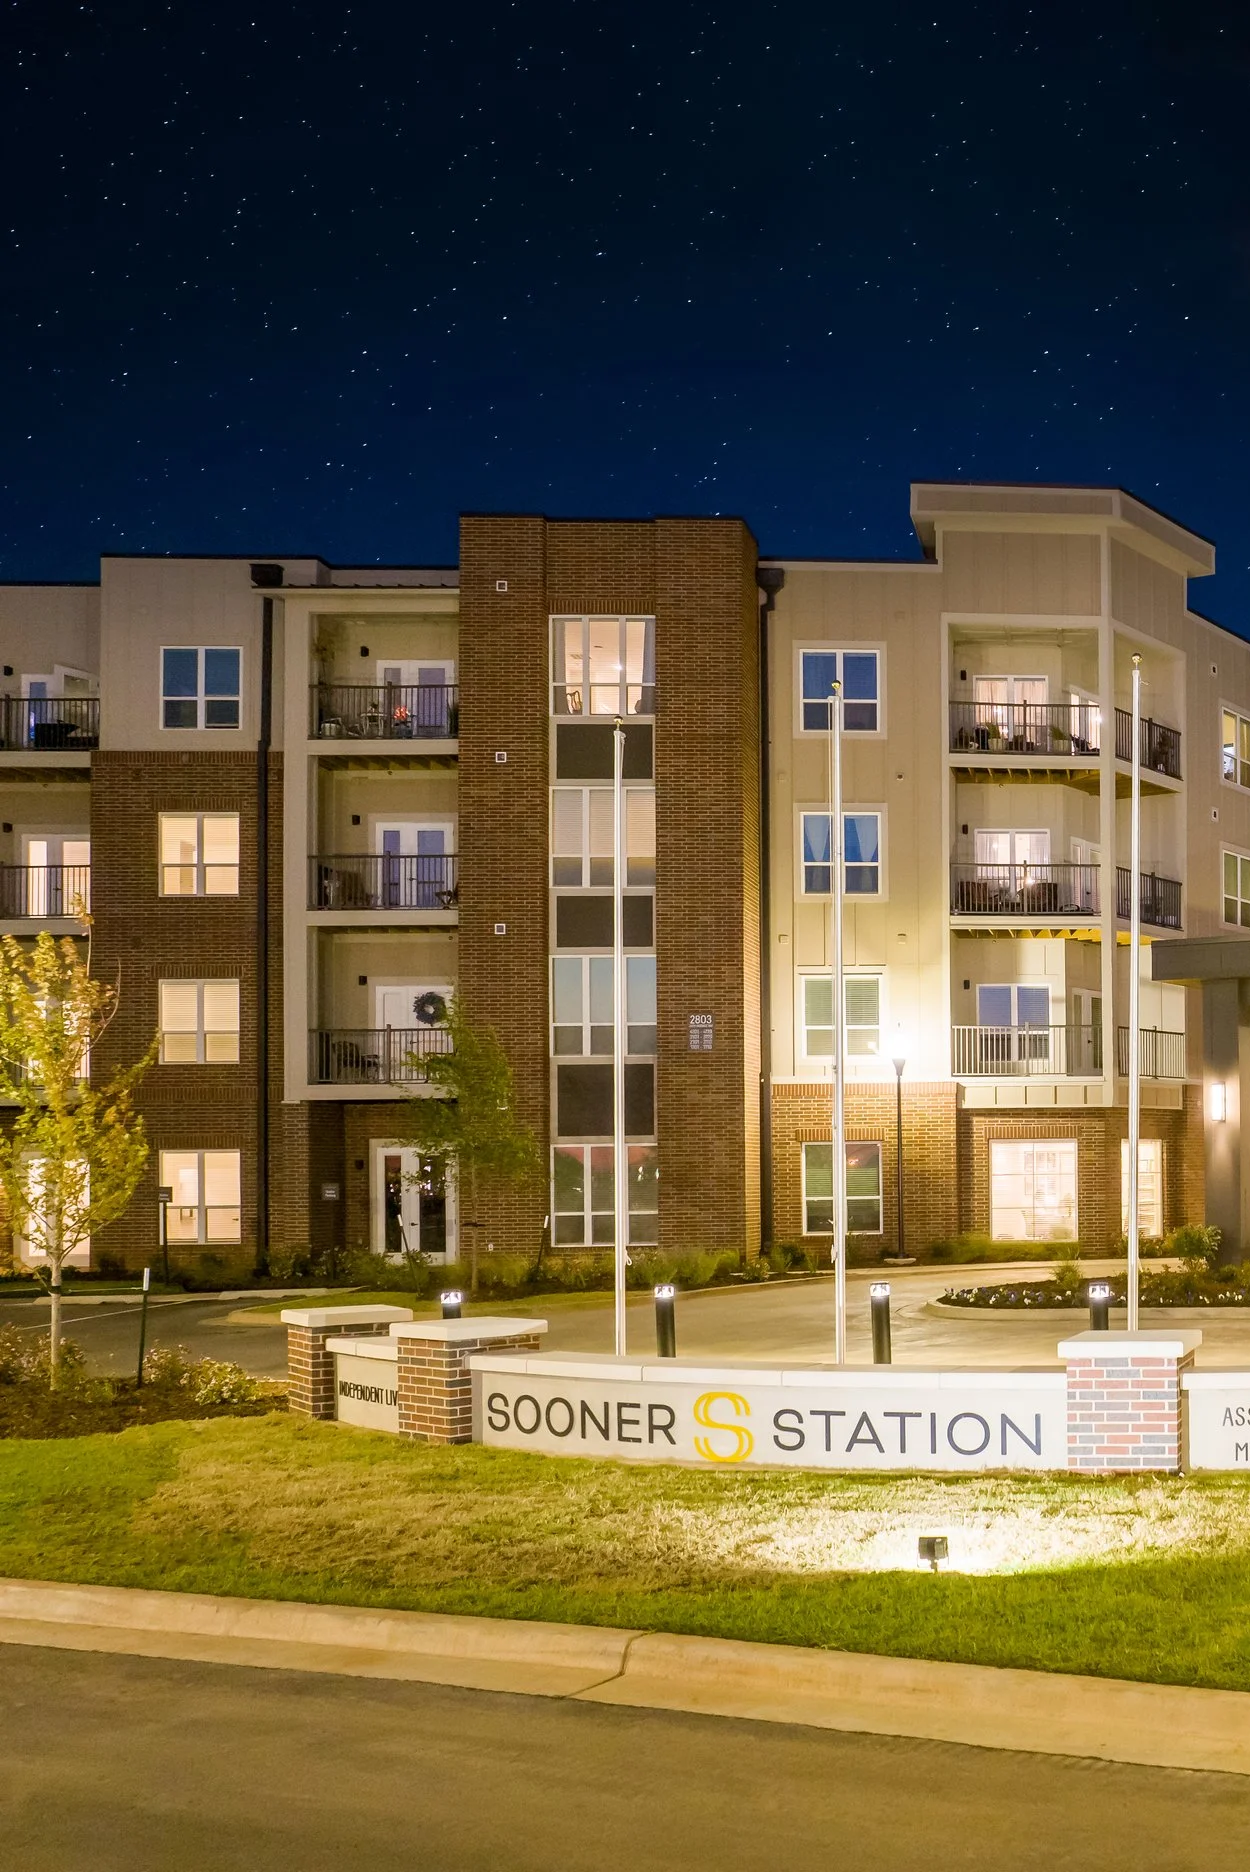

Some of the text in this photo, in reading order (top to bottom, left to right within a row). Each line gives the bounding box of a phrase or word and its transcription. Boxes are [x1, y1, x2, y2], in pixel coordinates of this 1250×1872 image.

[690, 1014, 712, 1024] 2803
[339, 1380, 384, 1404] INDEPENDENT
[487, 1392, 677, 1445] SOONER
[773, 1408, 1042, 1456] STATION
